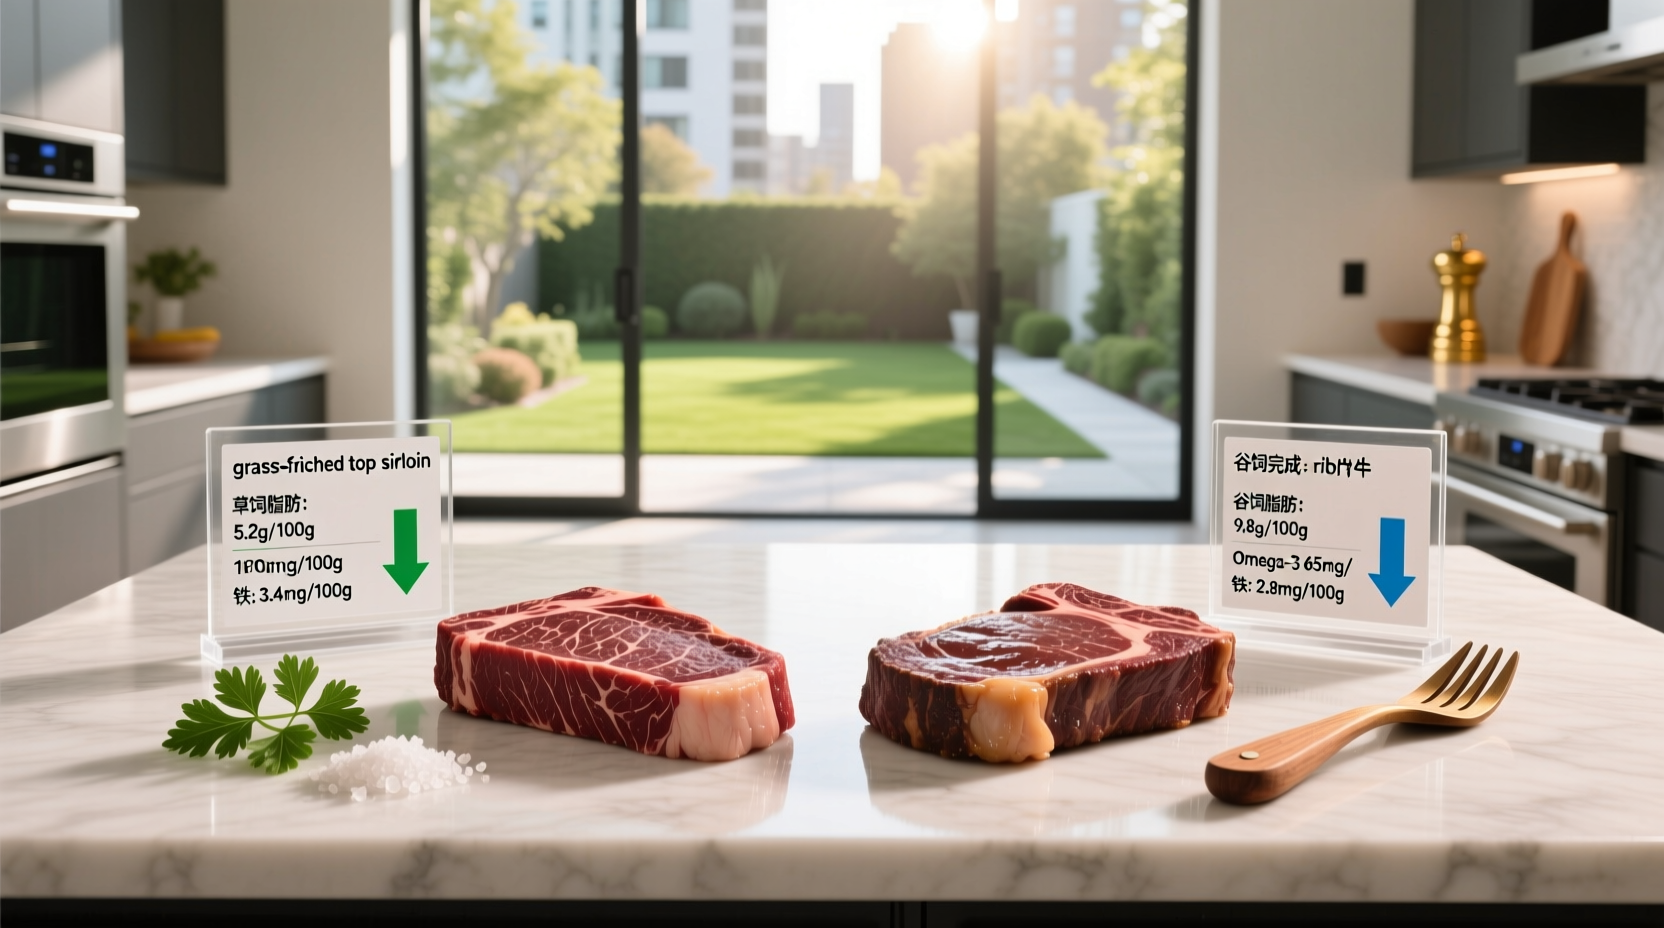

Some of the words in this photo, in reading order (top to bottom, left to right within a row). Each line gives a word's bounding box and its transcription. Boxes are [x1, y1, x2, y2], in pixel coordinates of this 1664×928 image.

[348, 454, 377, 475] top
[381, 451, 431, 471] sirloin
[233, 521, 315, 544] 5.2g/100g
[1303, 555, 1353, 578] 65mg/
[259, 582, 352, 605] 3.4mg/100g
[1256, 578, 1345, 605] 2.8mg/100g
